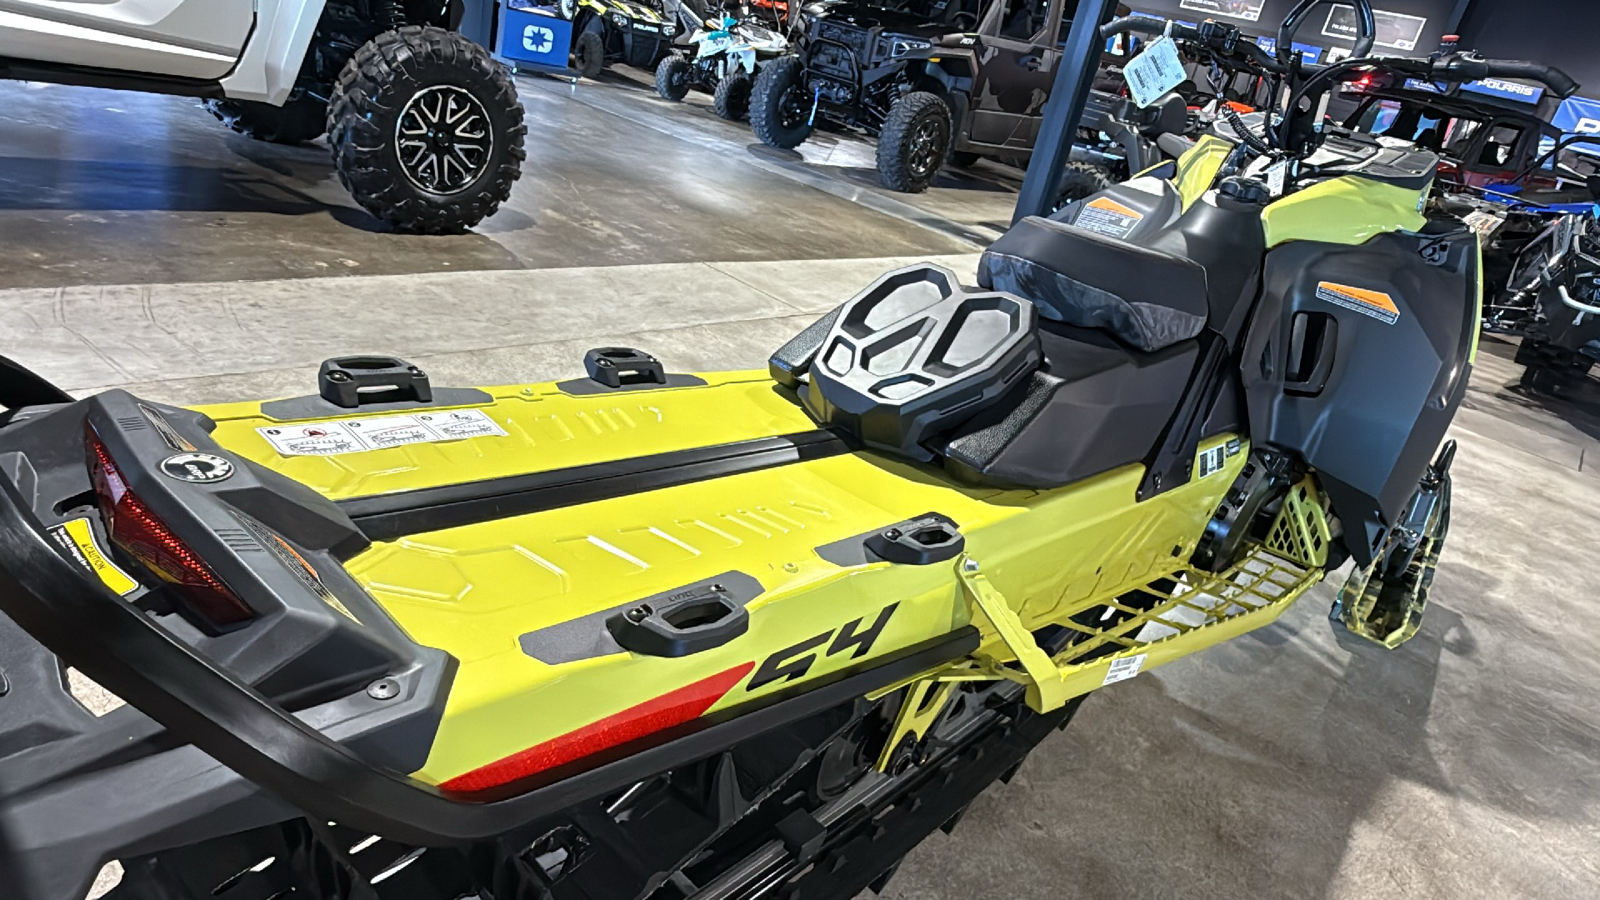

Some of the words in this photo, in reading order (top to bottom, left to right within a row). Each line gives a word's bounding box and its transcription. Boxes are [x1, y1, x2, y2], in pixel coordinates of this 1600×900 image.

[633, 23, 659, 33] POLARIS
[1477, 78, 1534, 96] POLARIS
[184, 464, 207, 479] BRP
[84, 544, 107, 571] CAUTION
